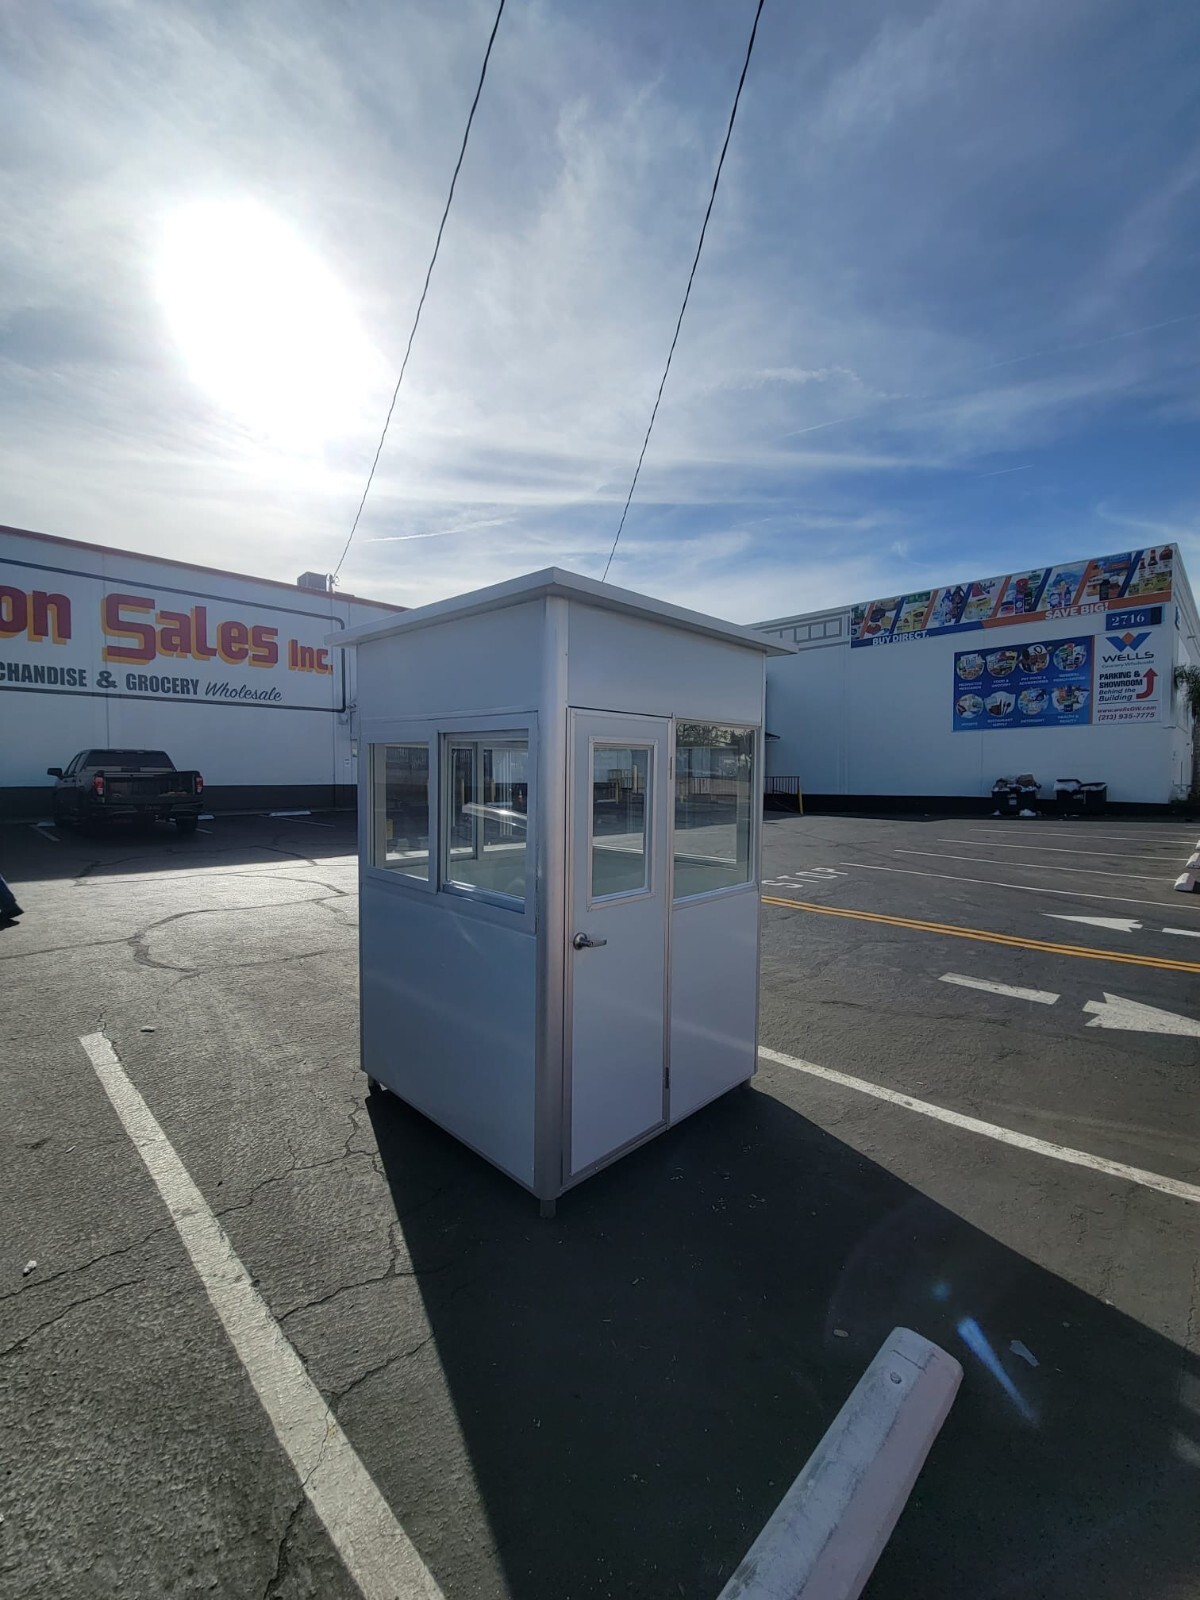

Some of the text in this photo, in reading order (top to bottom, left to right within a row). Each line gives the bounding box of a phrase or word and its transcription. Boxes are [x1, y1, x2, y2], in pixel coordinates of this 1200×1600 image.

[1045, 602, 1109, 619] SAVE BIG!
[1111, 613, 1145, 626] 2716
[101, 593, 279, 668] Sales
[288, 640, 334, 675] Inc.
[872, 630, 930, 646] BUY DIRECT.
[1102, 652, 1154, 662] WELLS
[1099, 672, 1131, 680] PARKING
[96, 670, 118, 689] &
[125, 673, 199, 696] GROCERY
[204, 680, 283, 702] Wholesale
[1099, 679, 1142, 688] SHOWROOM
[1098, 694, 1133, 702] Building
[1098, 713, 1117, 722] (213)
[761, 867, 849, 889] STOP
